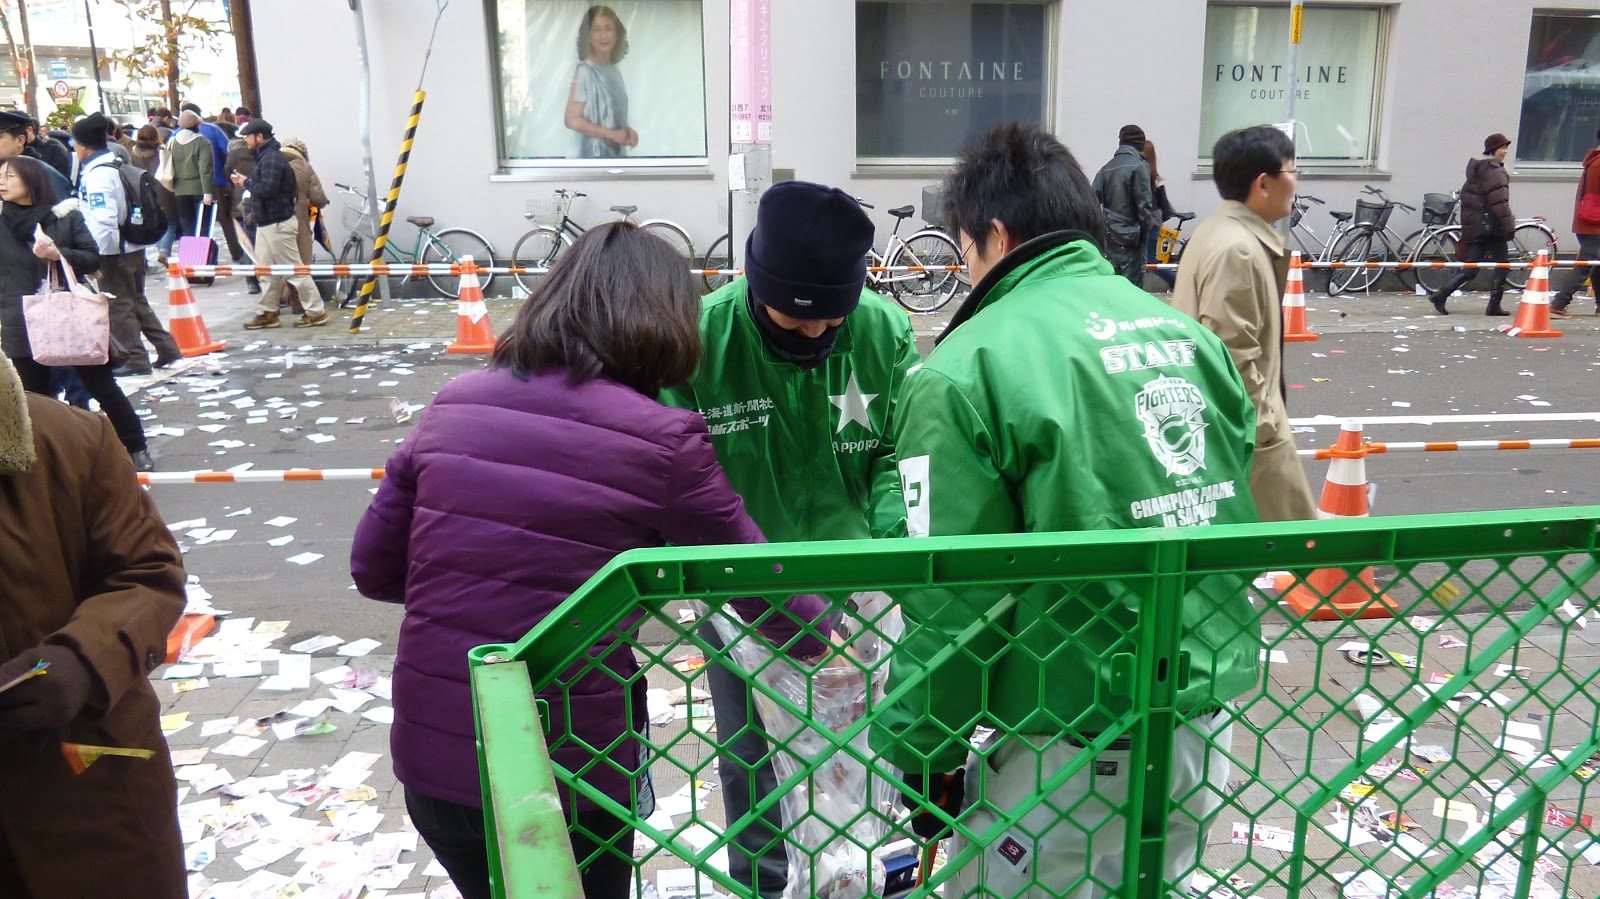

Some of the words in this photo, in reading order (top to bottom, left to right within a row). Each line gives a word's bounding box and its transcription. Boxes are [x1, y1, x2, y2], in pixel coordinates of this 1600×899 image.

[759, 0, 769, 100] キンクリニック
[880, 61, 1023, 80] FONTAINE
[1215, 64, 1347, 83] FONTINE
[919, 87, 984, 98] COUTURE
[1250, 89, 1310, 100] COUTRE
[1100, 338, 1197, 374] STAFF
[1137, 386, 1203, 416] FIGHTERS
[706, 414, 770, 435] 新スポーツ
[832, 438, 880, 454] APPORO
[1131, 488, 1200, 519] CHAMPIOS
